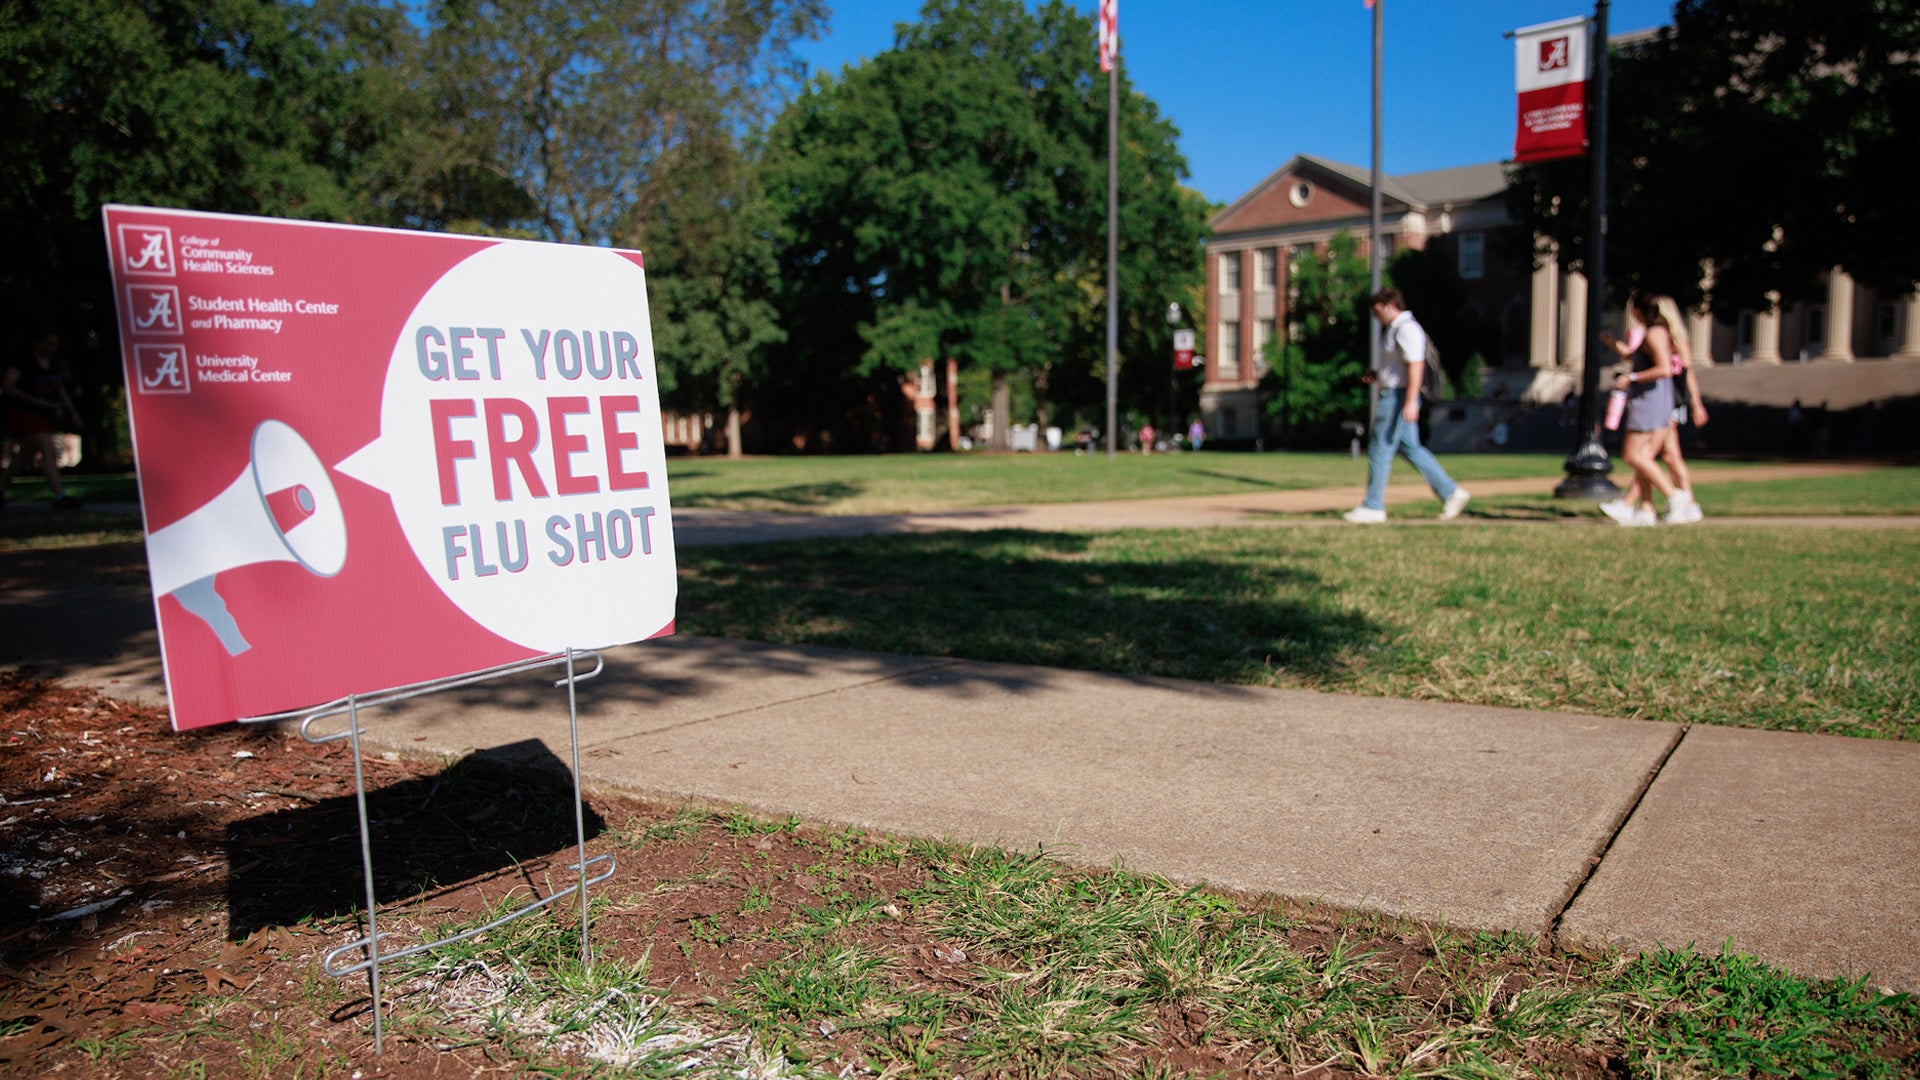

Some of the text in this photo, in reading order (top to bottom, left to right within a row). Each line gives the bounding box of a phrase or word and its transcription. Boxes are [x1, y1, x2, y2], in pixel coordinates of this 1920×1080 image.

[180, 236, 219, 247] College of
[128, 233, 168, 270] A
[181, 246, 253, 264] Community
[183, 260, 274, 276] Health Sciences
[136, 292, 176, 328] A
[188, 296, 339, 315] Student Health Center
[190, 315, 283, 334] and Pharmacy
[196, 355, 258, 369] University
[415, 325, 643, 381] GET YOUR
[144, 352, 184, 387] A
[197, 370, 292, 383] Medical Center
[429, 394, 650, 507] FREE
[442, 506, 655, 581] FLU SHOT
